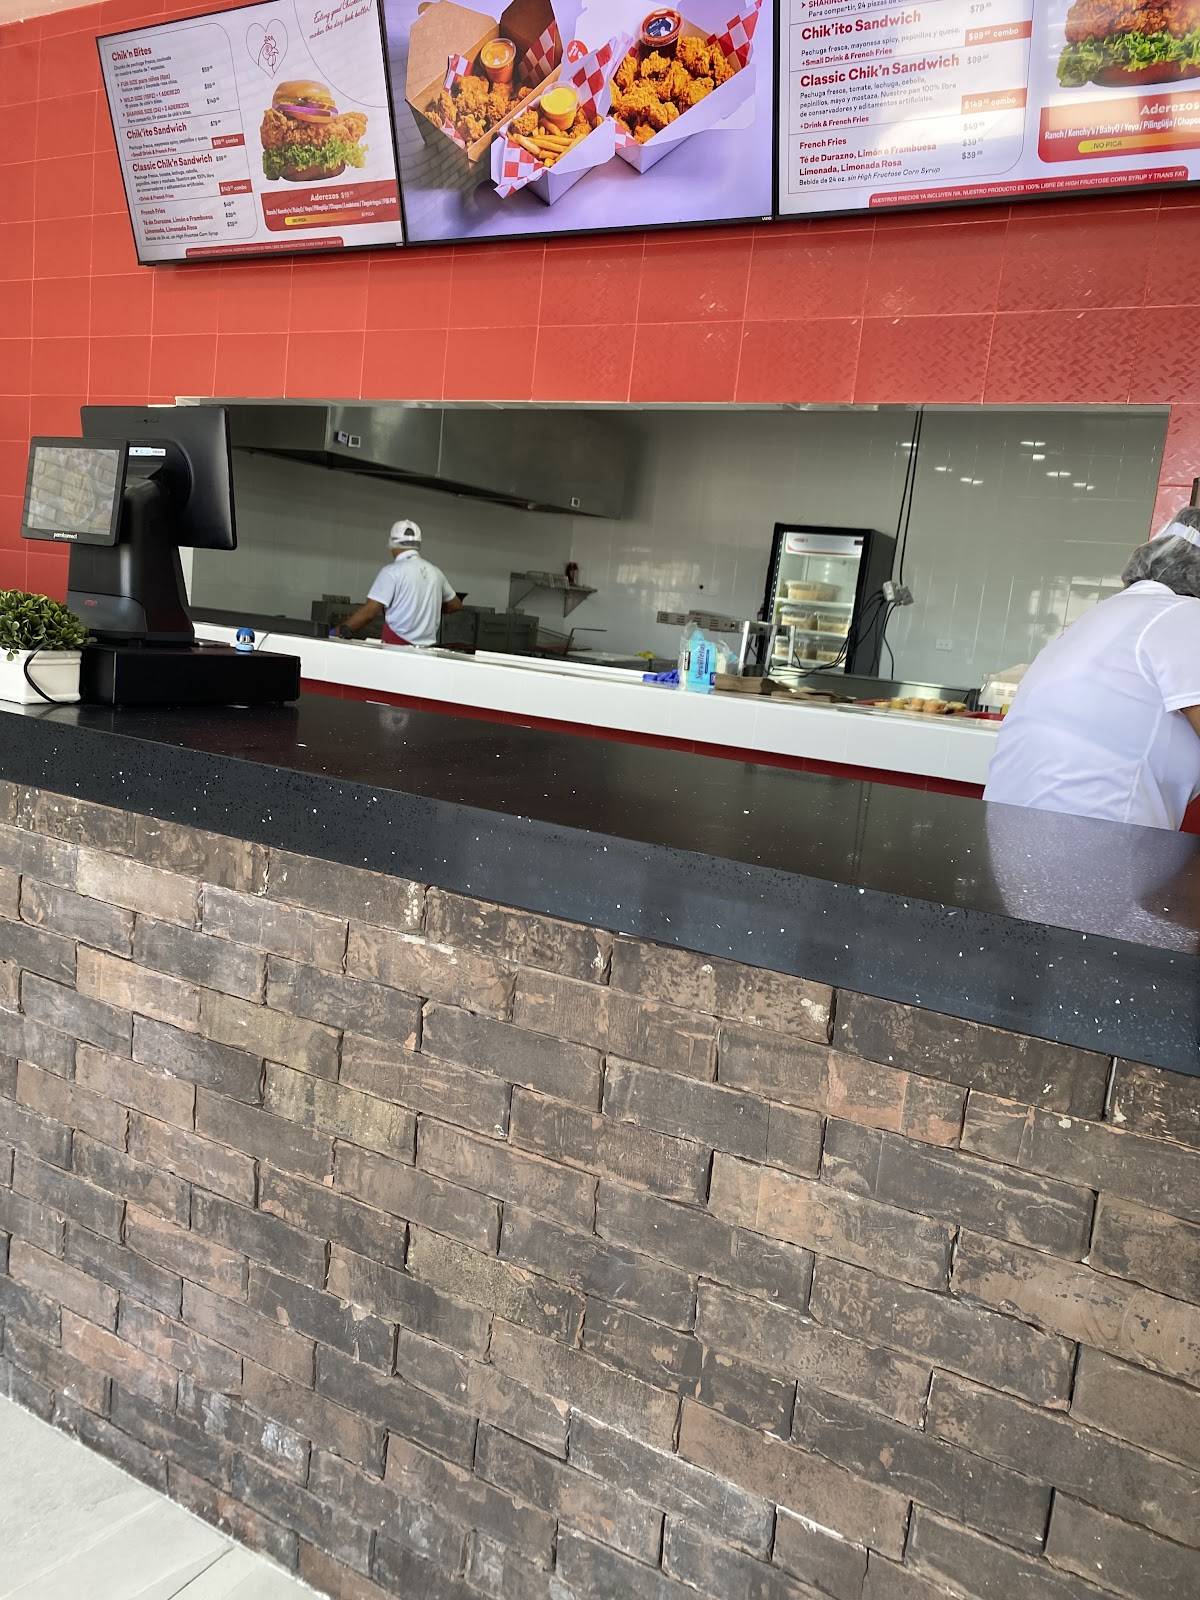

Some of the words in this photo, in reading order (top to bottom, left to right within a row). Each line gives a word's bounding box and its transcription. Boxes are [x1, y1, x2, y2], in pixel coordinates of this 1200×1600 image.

[808, 8, 822, 17] Para
[801, 20, 852, 40] Chik'ito
[855, 9, 920, 32] Sandwich
[993, 25, 1018, 37] combo
[111, 48, 133, 61] Chik'n
[134, 44, 152, 57] Bites
[801, 46, 826, 57] Pechuga
[828, 43, 849, 53] fresca,
[850, 38, 880, 50] mayonesa
[824, 53, 843, 63] Drink
[850, 49, 874, 59] French
[875, 46, 892, 56] Fries
[800, 69, 845, 87] Classic
[848, 63, 889, 80] Chik'n
[892, 53, 959, 75] Sandwich
[800, 89, 825, 99] Pechuga
[849, 83, 872, 93] tomate,
[880, 88, 906, 97] Nuestro
[990, 94, 1016, 106] combo
[1139, 98, 1200, 115] Aderezos
[808, 105, 852, 116] conservadores
[828, 117, 851, 126] French
[852, 115, 868, 123] Fries
[153, 122, 186, 135] Sandwich
[1044, 129, 1064, 140] Ranch
[799, 139, 825, 149] French
[827, 136, 846, 146] Fries
[821, 151, 856, 162] Durazno,
[890, 142, 936, 154] Frambuesa
[132, 160, 156, 171] Classic
[157, 158, 178, 168] Chik'n
[178, 153, 212, 166] Sandwich
[799, 164, 839, 175] Limonada,
[840, 160, 880, 171] Limonada
[881, 158, 901, 167] Rosa
[873, 169, 901, 178] Fructose
[903, 167, 919, 175] Corn
[920, 166, 940, 174] Syrup
[310, 191, 339, 201] Aderezos
